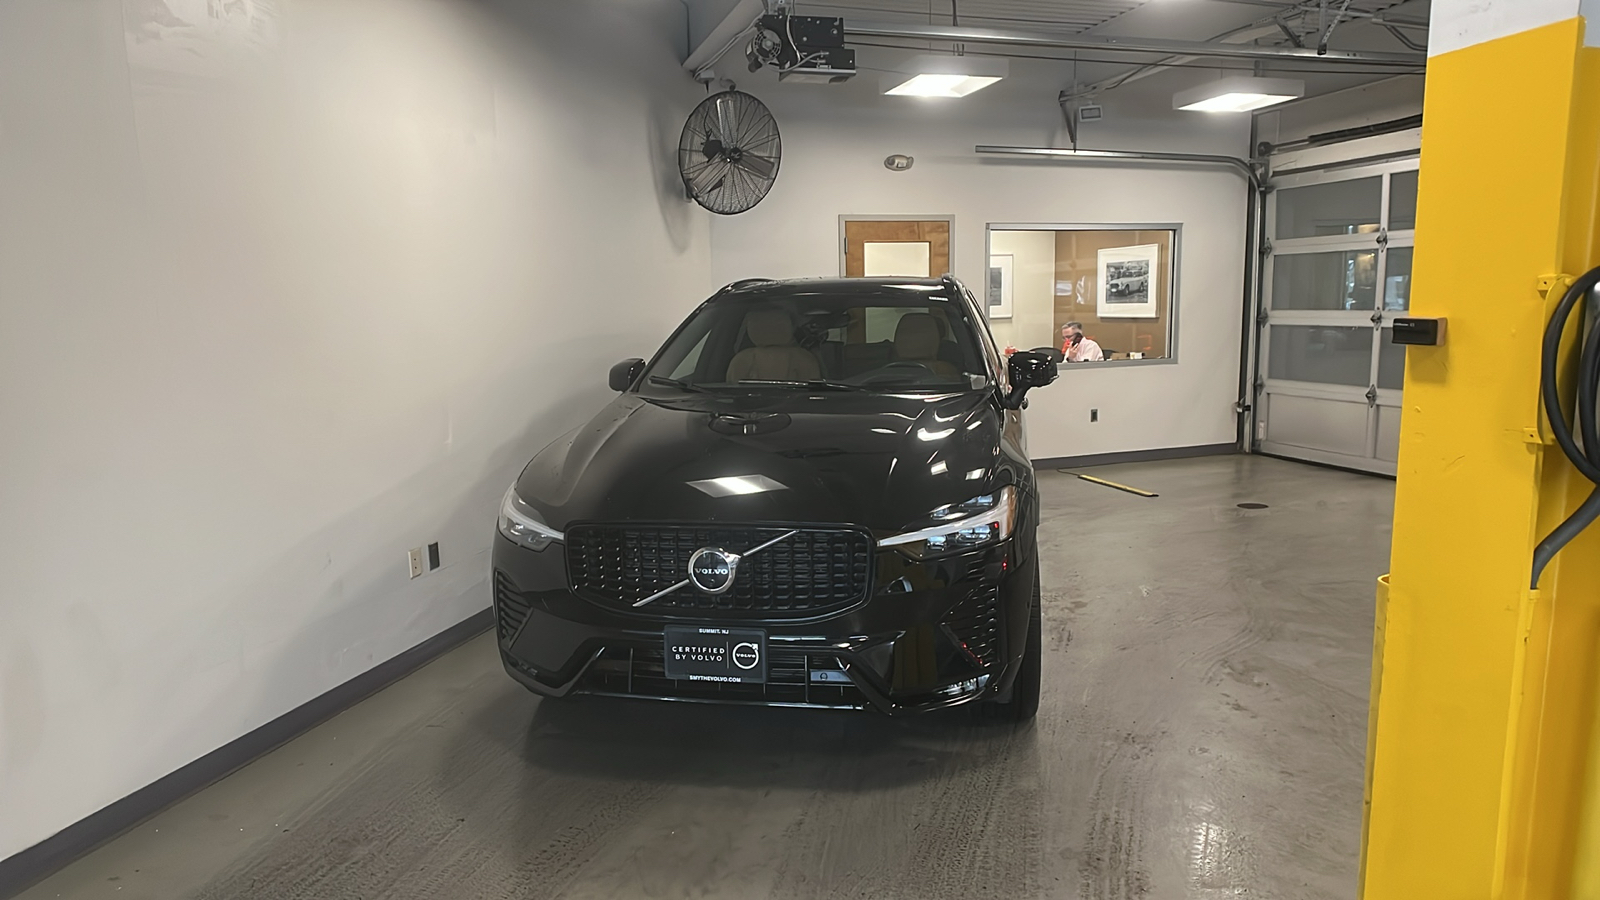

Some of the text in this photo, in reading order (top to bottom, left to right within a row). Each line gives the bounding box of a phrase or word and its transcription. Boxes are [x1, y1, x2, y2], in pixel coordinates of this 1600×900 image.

[671, 646, 725, 654] CERTIFIED
[691, 654, 722, 662] VOLVO
[689, 675, 742, 683] SMYTHEVOLVO.COM
